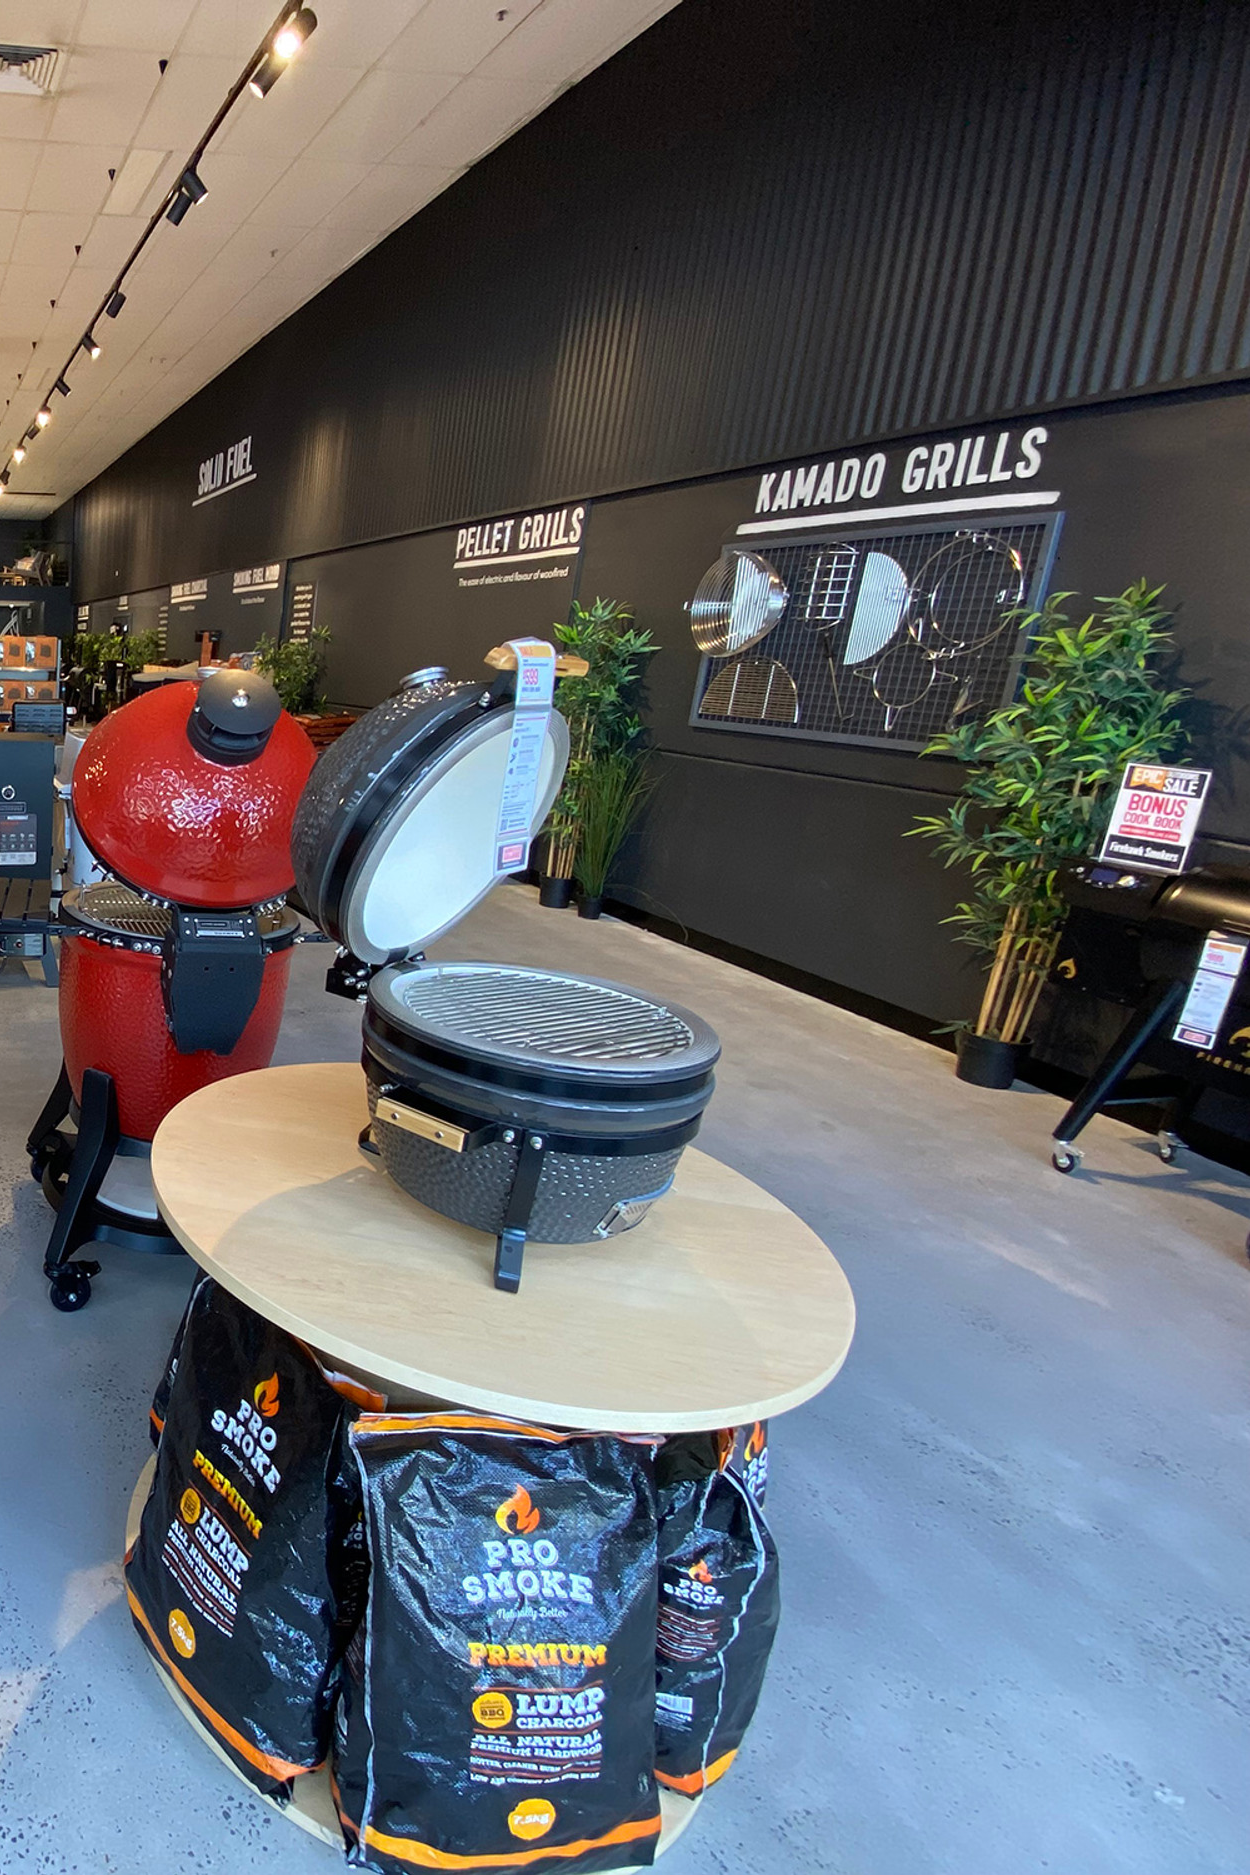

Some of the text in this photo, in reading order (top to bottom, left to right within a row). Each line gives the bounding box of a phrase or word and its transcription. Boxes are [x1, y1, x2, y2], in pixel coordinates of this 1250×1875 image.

[198, 434, 253, 496] SOLID FUEL
[755, 426, 1048, 514] KAMADO GRILLS
[455, 506, 585, 559] PELLET GRILLS
[458, 577, 467, 587] The
[485, 574, 504, 585] electric
[503, 572, 514, 583] and
[514, 571, 533, 582] flavour
[533, 569, 541, 580] of
[1132, 767, 1164, 784] EPIC
[1162, 778, 1199, 796] SALE
[1128, 793, 1188, 818] BONUS
[1123, 812, 1184, 830] COOK BOOK
[1144, 846, 1180, 863] Smokers
[237, 1398, 278, 1451] PRO
[210, 1409, 282, 1494] SMOKE
[192, 1448, 263, 1540] PREMIUM
[199, 1506, 249, 1573] LUMP
[171, 1519, 189, 1548] ALL
[188, 1543, 238, 1609] NATURAL
[195, 1526, 242, 1590] CHARCOAL
[483, 1538, 559, 1568] PRO
[168, 1528, 195, 1570] PREMIUM
[194, 1566, 237, 1615] HARDWOOD
[462, 1570, 594, 1605] SMOKE
[663, 1582, 725, 1605] SMOKE
[678, 1578, 717, 1595] PRO
[538, 1606, 569, 1618] Better
[467, 1642, 608, 1667] PREMIUM
[480, 1708, 505, 1717] BBQ
[516, 1687, 605, 1717] LUMP
[516, 1711, 603, 1729] CHARCOAL
[470, 1742, 602, 1758] PREMIUM HARDWOOD
[472, 1729, 602, 1748] ALL NATURAL
[470, 1772, 489, 1782] LOW
[502, 1761, 539, 1771] CLEANER
